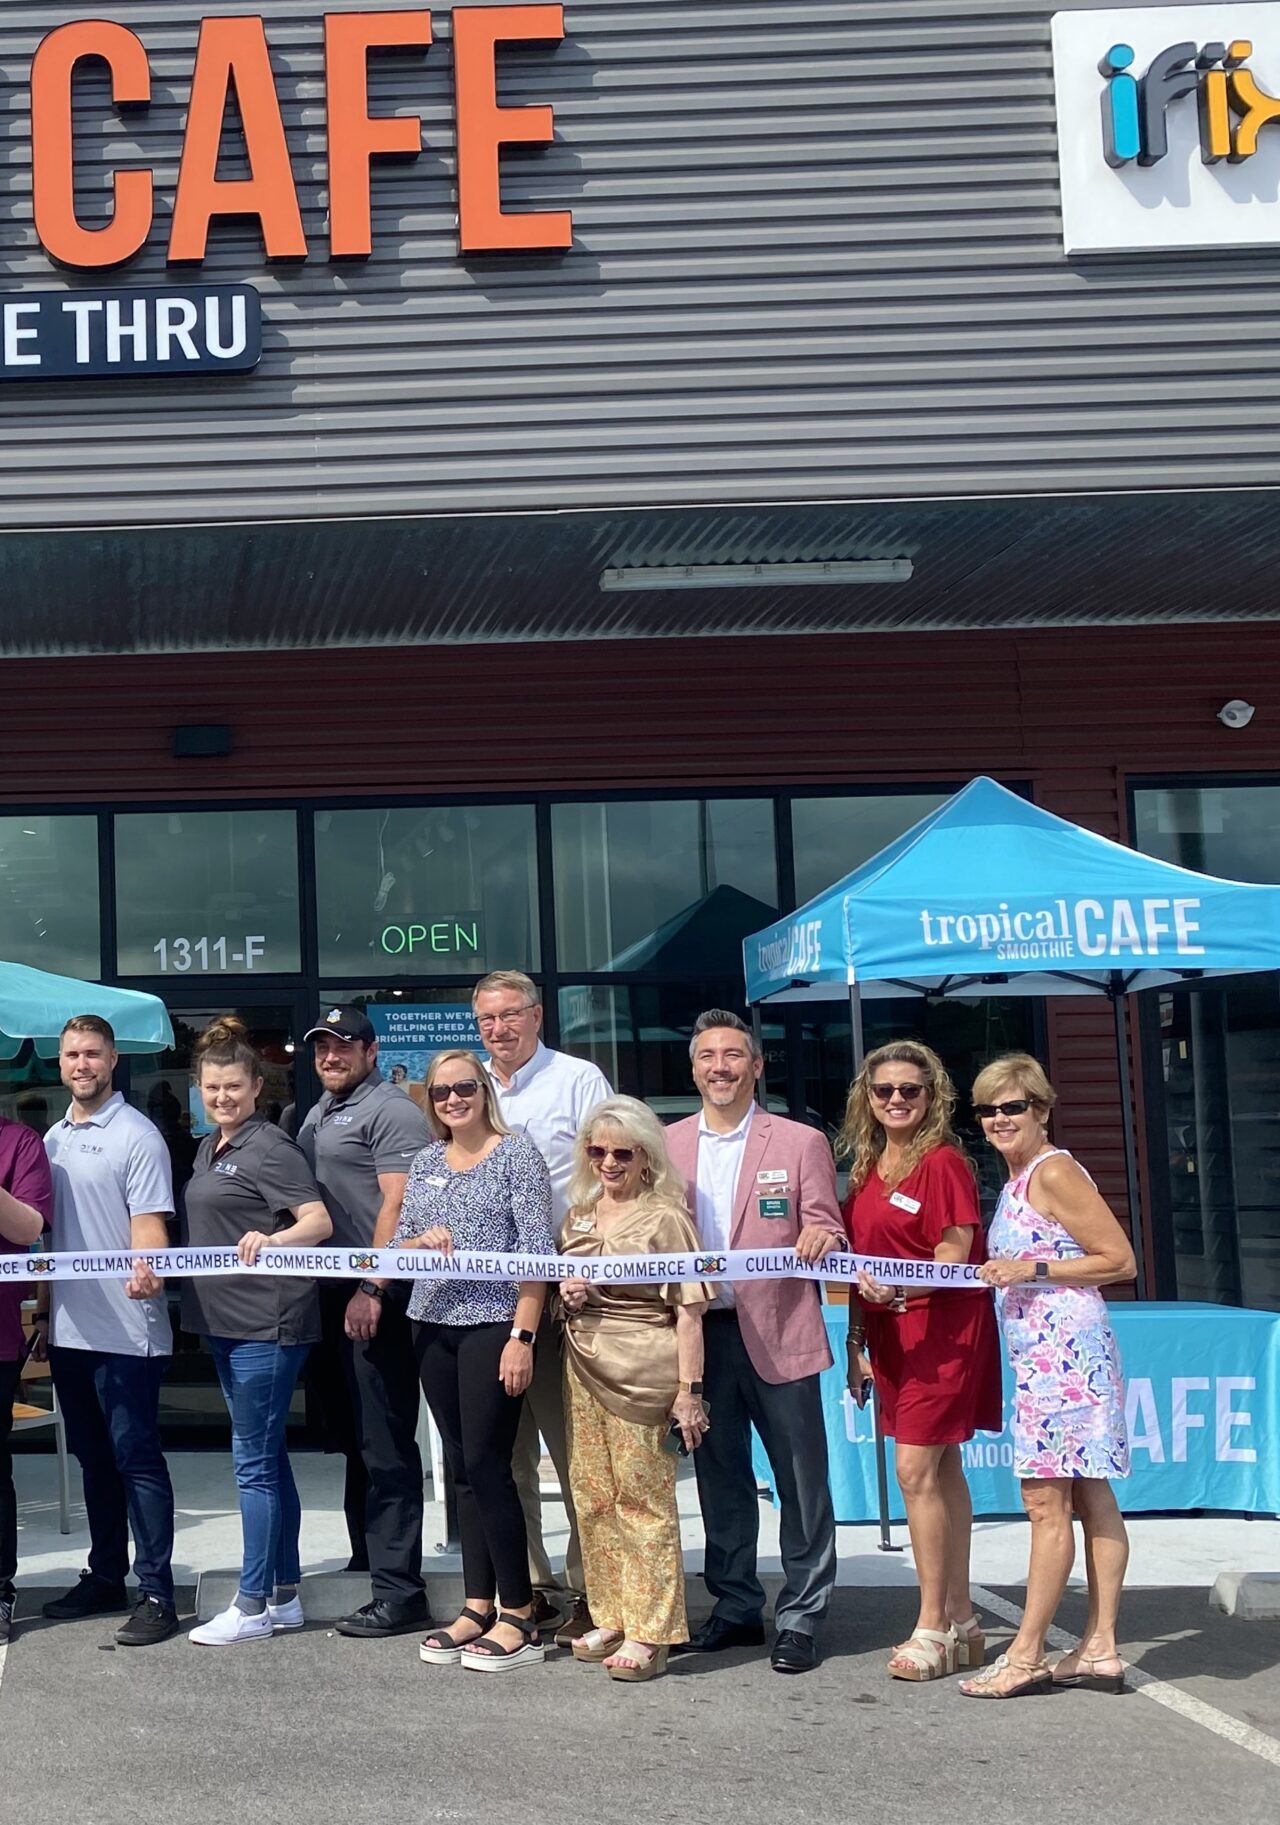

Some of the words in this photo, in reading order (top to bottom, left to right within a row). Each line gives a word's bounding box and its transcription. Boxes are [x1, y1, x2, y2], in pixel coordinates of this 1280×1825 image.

[30, 3, 573, 269] CAFE
[62, 295, 247, 364] THRU
[381, 922, 478, 953] OPEN
[919, 900, 1073, 950] tropical
[1074, 898, 1205, 957] CAFE
[153, 935, 266, 971] 1311-F
[787, 920, 822, 977] CAFE
[997, 941, 1075, 960] SMOOTHIE
[385, 1012, 441, 1021] TOGETHER
[389, 1023, 434, 1032] HELPING
[438, 1023, 465, 1031] FEED
[468, 1023, 476, 1031] A
[429, 1034, 481, 1042] TOMORRO
[72, 1257, 133, 1273] CULLMAN
[140, 1255, 172, 1271] REA
[176, 1253, 240, 1269] CHAMBER
[266, 1254, 341, 1270] COMMERCE
[397, 1256, 461, 1273] CULLMAN
[465, 1258, 502, 1275] AREA
[506, 1261, 575, 1278] CHAMBER
[582, 1263, 599, 1279] OF
[603, 1260, 686, 1278] COMMERCE
[746, 1256, 814, 1273] CULLMAN
[820, 1258, 857, 1274] AREA
[863, 1261, 934, 1279] CHAMBER
[940, 1264, 963, 1279] OF
[1124, 1376, 1257, 1463] AFE
